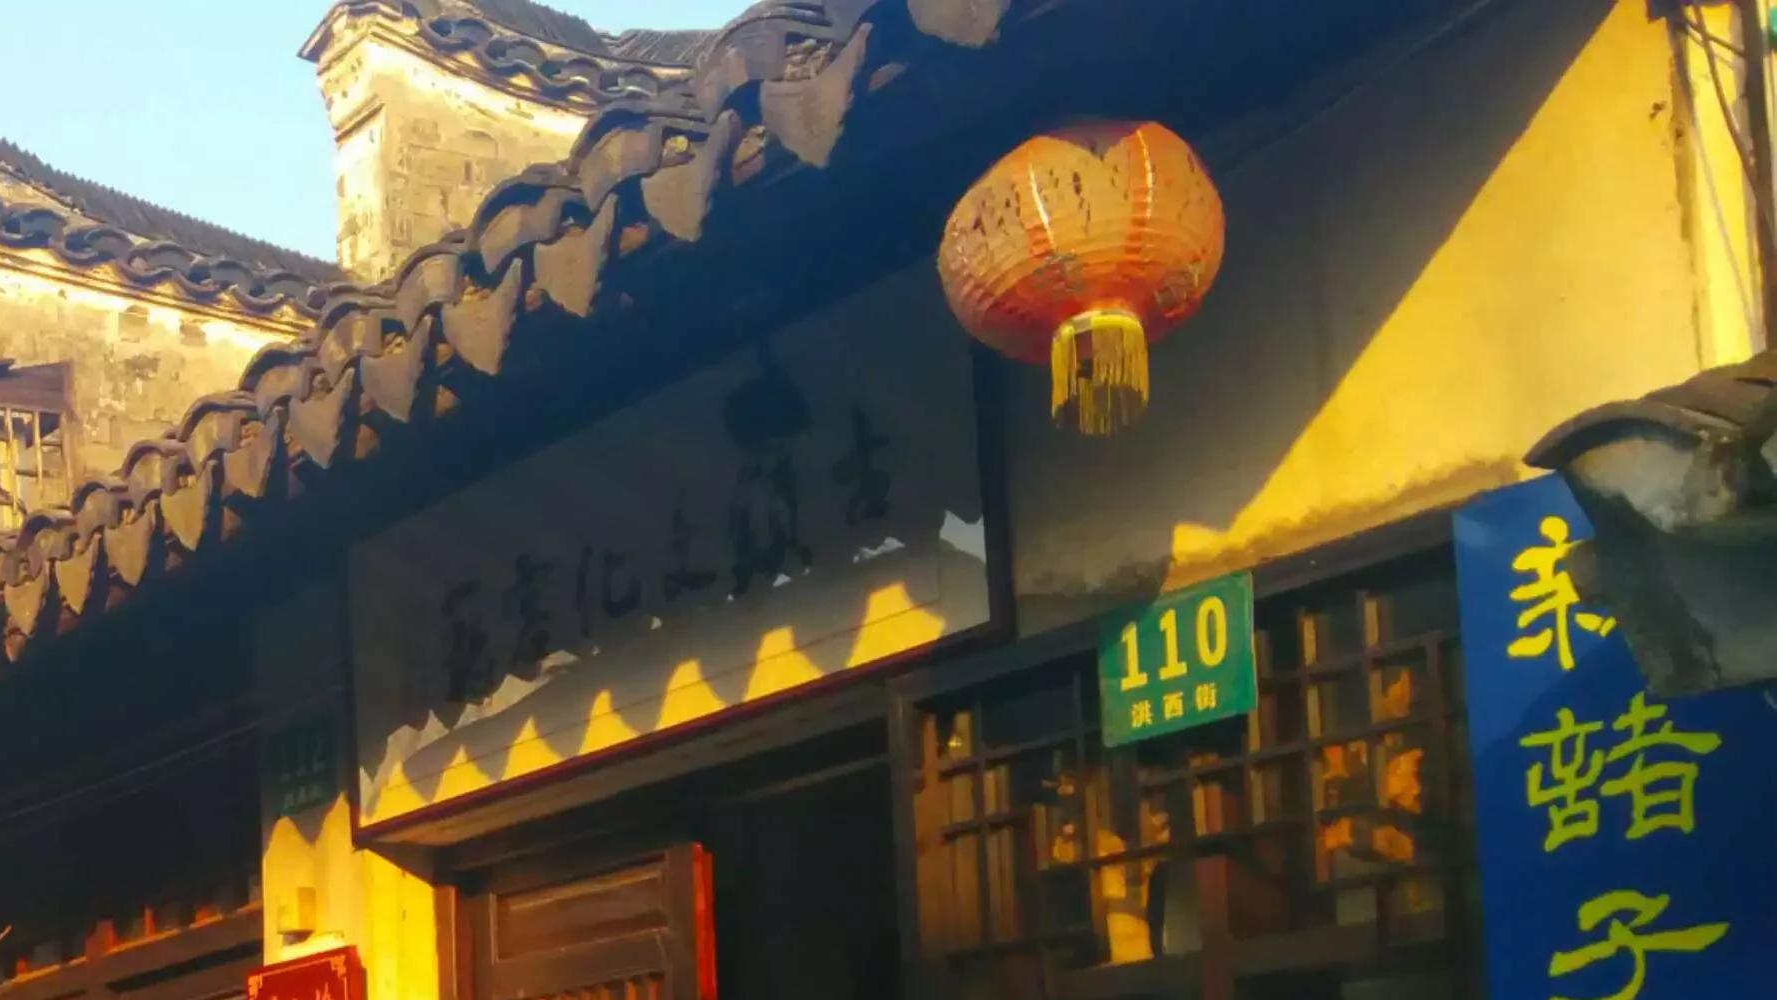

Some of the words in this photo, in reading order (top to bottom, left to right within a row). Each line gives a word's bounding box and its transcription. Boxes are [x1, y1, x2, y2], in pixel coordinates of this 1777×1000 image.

[1119, 595, 1227, 691] 110
[1130, 682, 1217, 728] 洪西街
